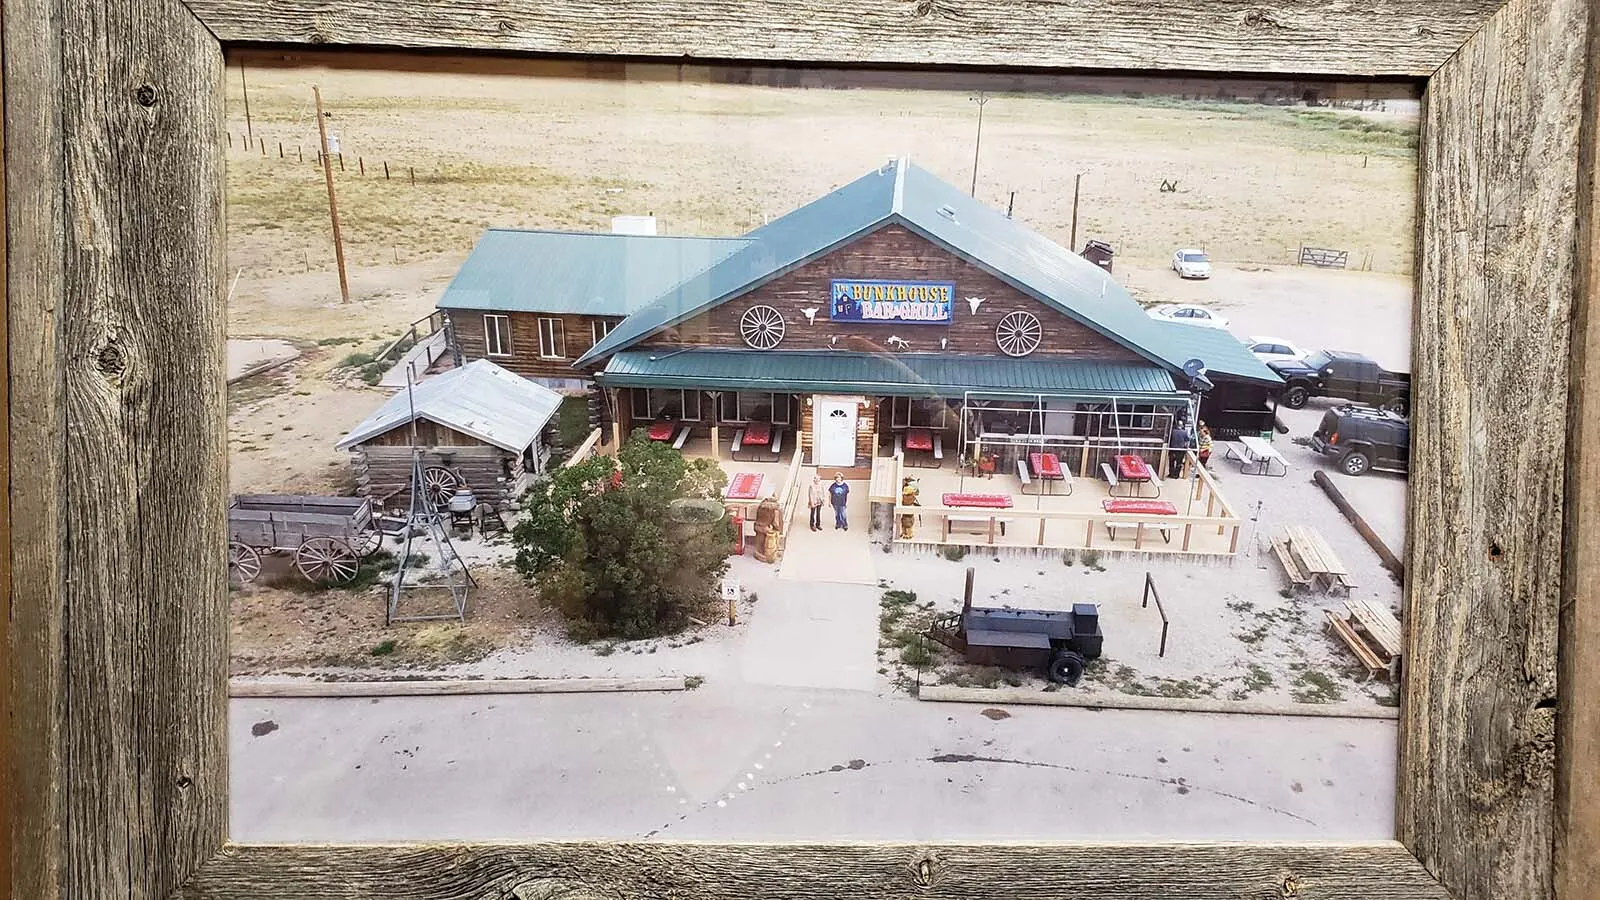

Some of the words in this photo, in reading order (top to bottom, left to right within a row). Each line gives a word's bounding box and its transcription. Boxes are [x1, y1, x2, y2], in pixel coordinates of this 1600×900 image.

[852, 285, 948, 302] BUNKHOUSE
[862, 302, 893, 319] BAR
[900, 303, 948, 320] GRILL
